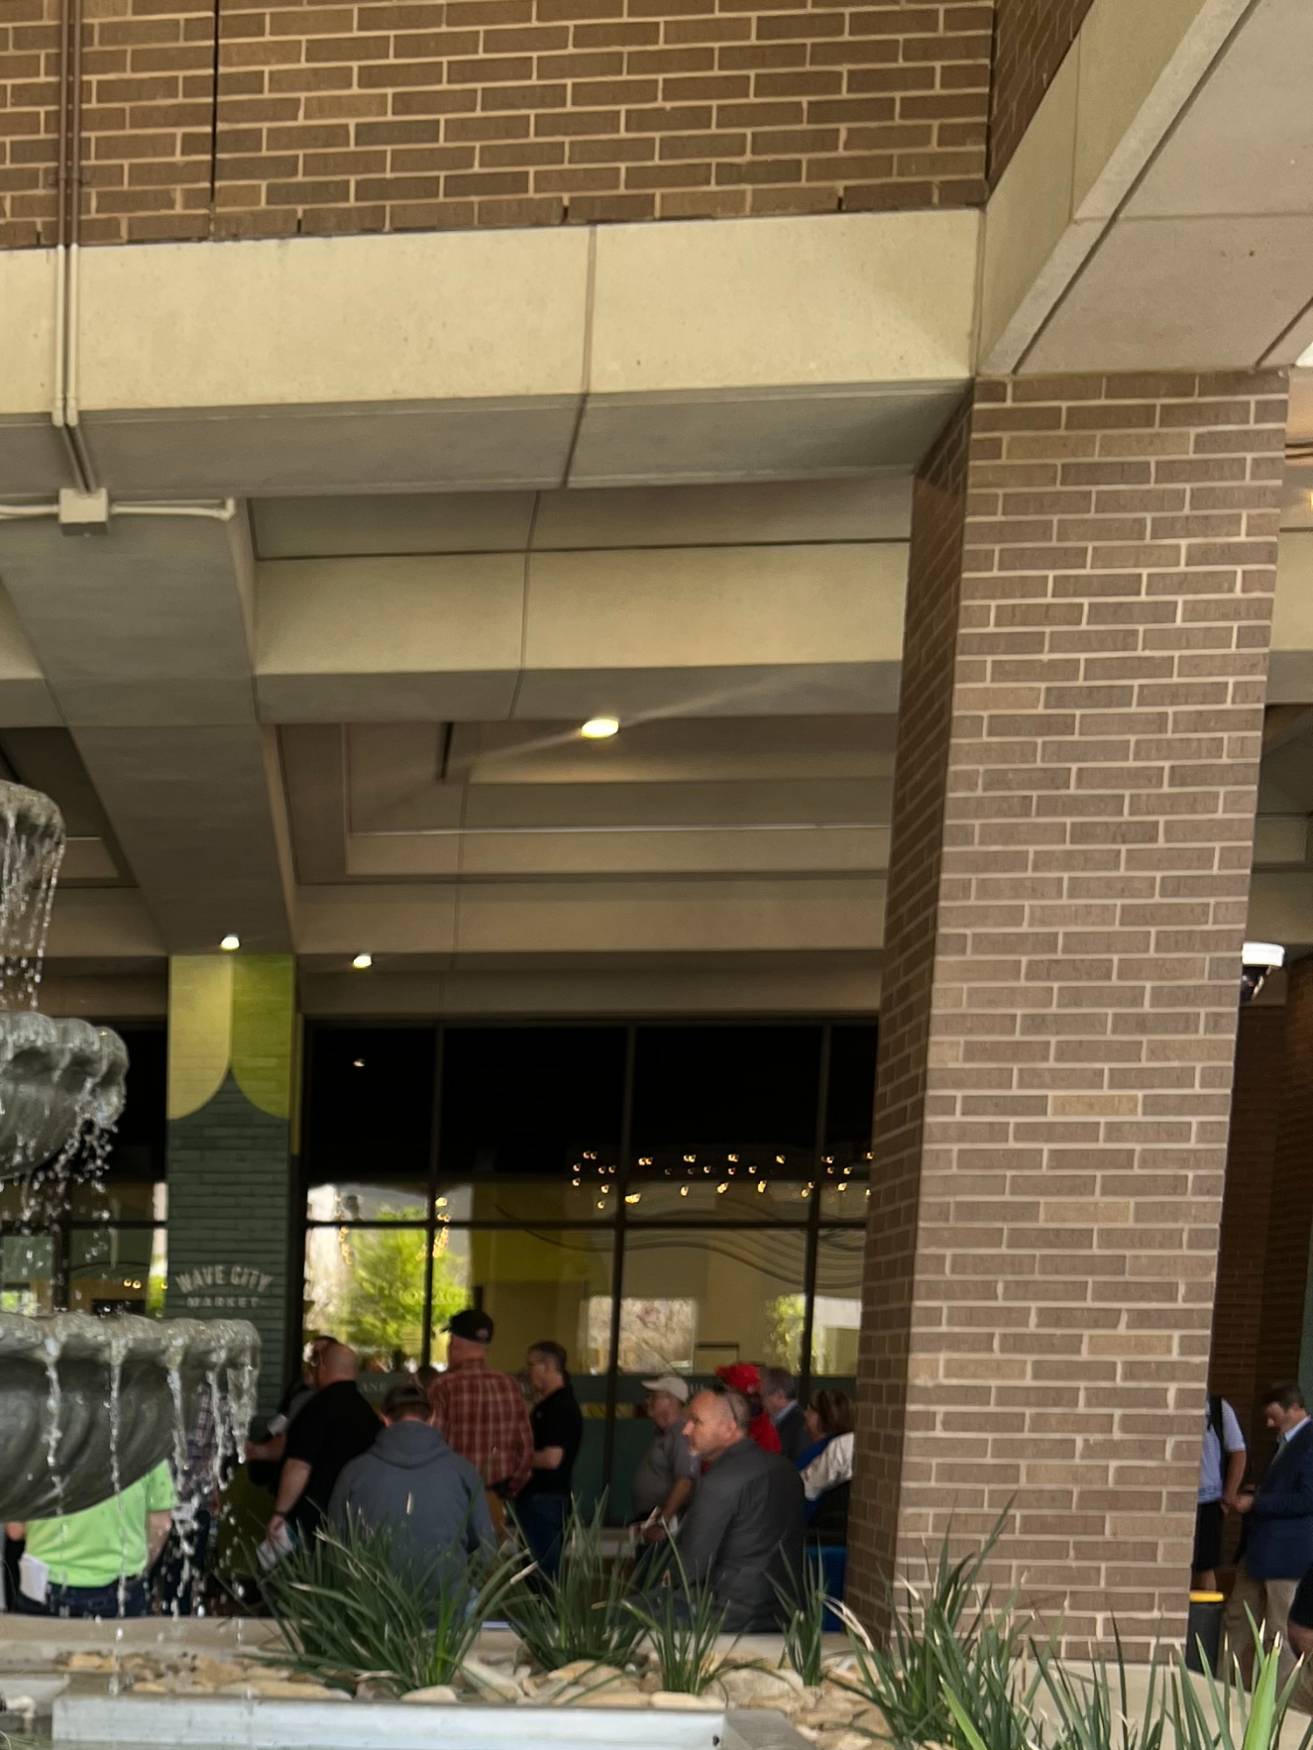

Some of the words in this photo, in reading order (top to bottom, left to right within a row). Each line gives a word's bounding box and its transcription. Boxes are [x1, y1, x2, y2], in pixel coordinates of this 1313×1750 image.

[175, 1265, 225, 1294] WAVE
[230, 1265, 273, 1292] CITY
[187, 1296, 259, 1308] MARKET
